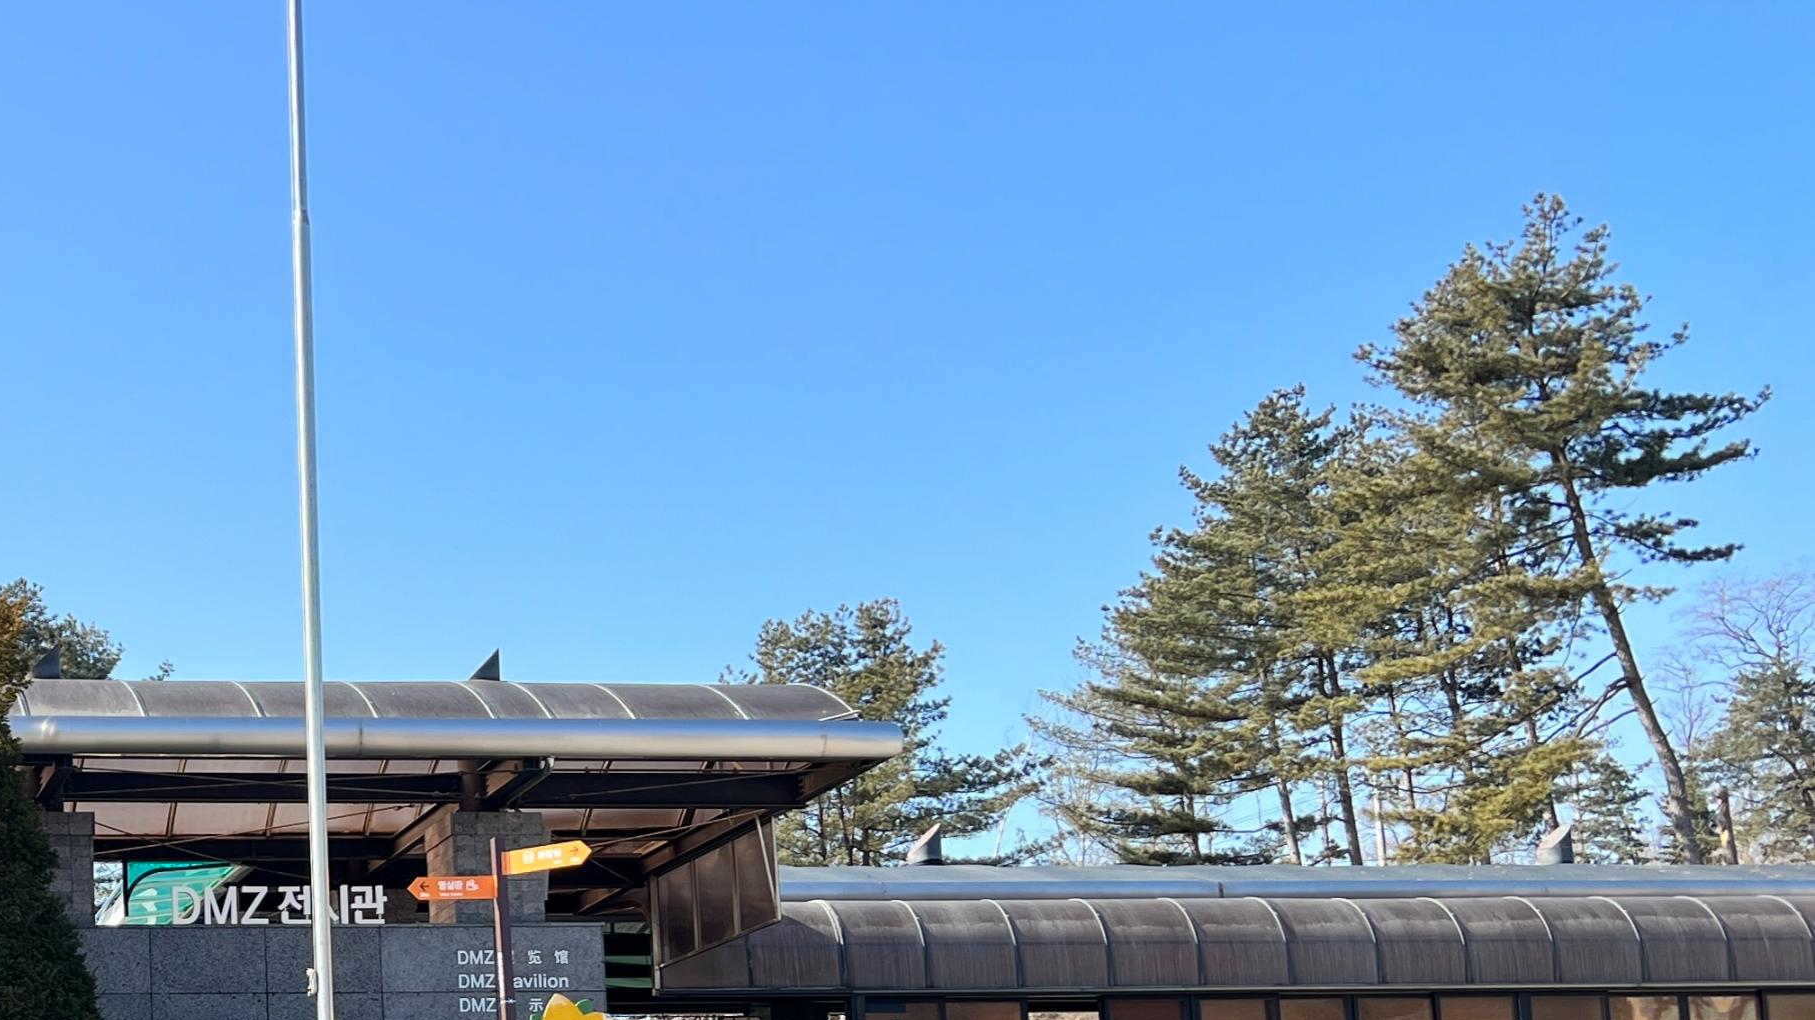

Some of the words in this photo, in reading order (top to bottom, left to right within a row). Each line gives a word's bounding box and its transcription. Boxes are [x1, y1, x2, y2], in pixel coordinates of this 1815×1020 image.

[171, 884, 269, 926] DMZ
[457, 950, 495, 965] DMZ
[458, 974, 496, 989] DMZ
[513, 973, 569, 989] avilion
[459, 997, 497, 1013] DMZ
